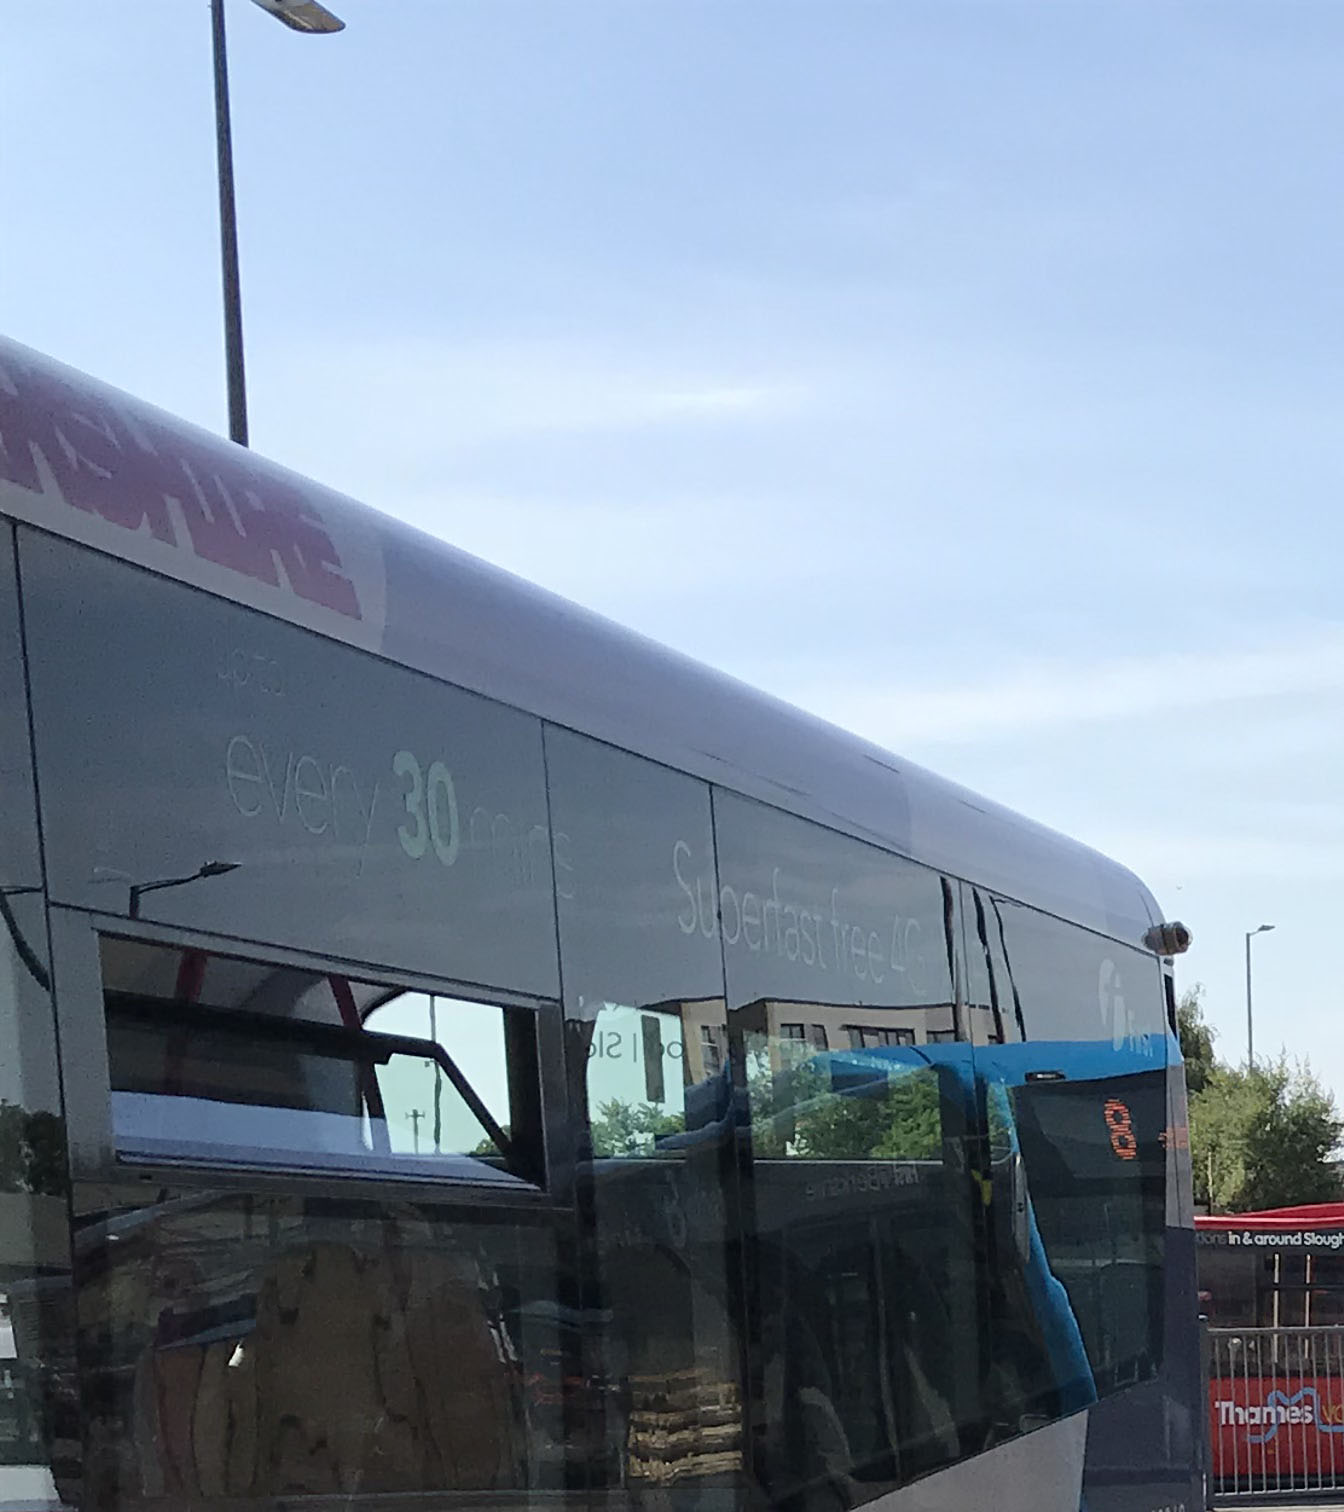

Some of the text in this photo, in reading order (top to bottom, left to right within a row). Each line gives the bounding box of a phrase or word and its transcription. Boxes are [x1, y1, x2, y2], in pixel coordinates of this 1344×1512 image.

[226, 735, 381, 879] every
[392, 749, 460, 867] 30
[672, 839, 827, 970] Superfast
[830, 886, 885, 985] free
[1228, 1231, 1241, 1246] in
[1242, 1231, 1254, 1246] &
[1254, 1231, 1303, 1247] around
[1213, 1400, 1315, 1425] Thames
